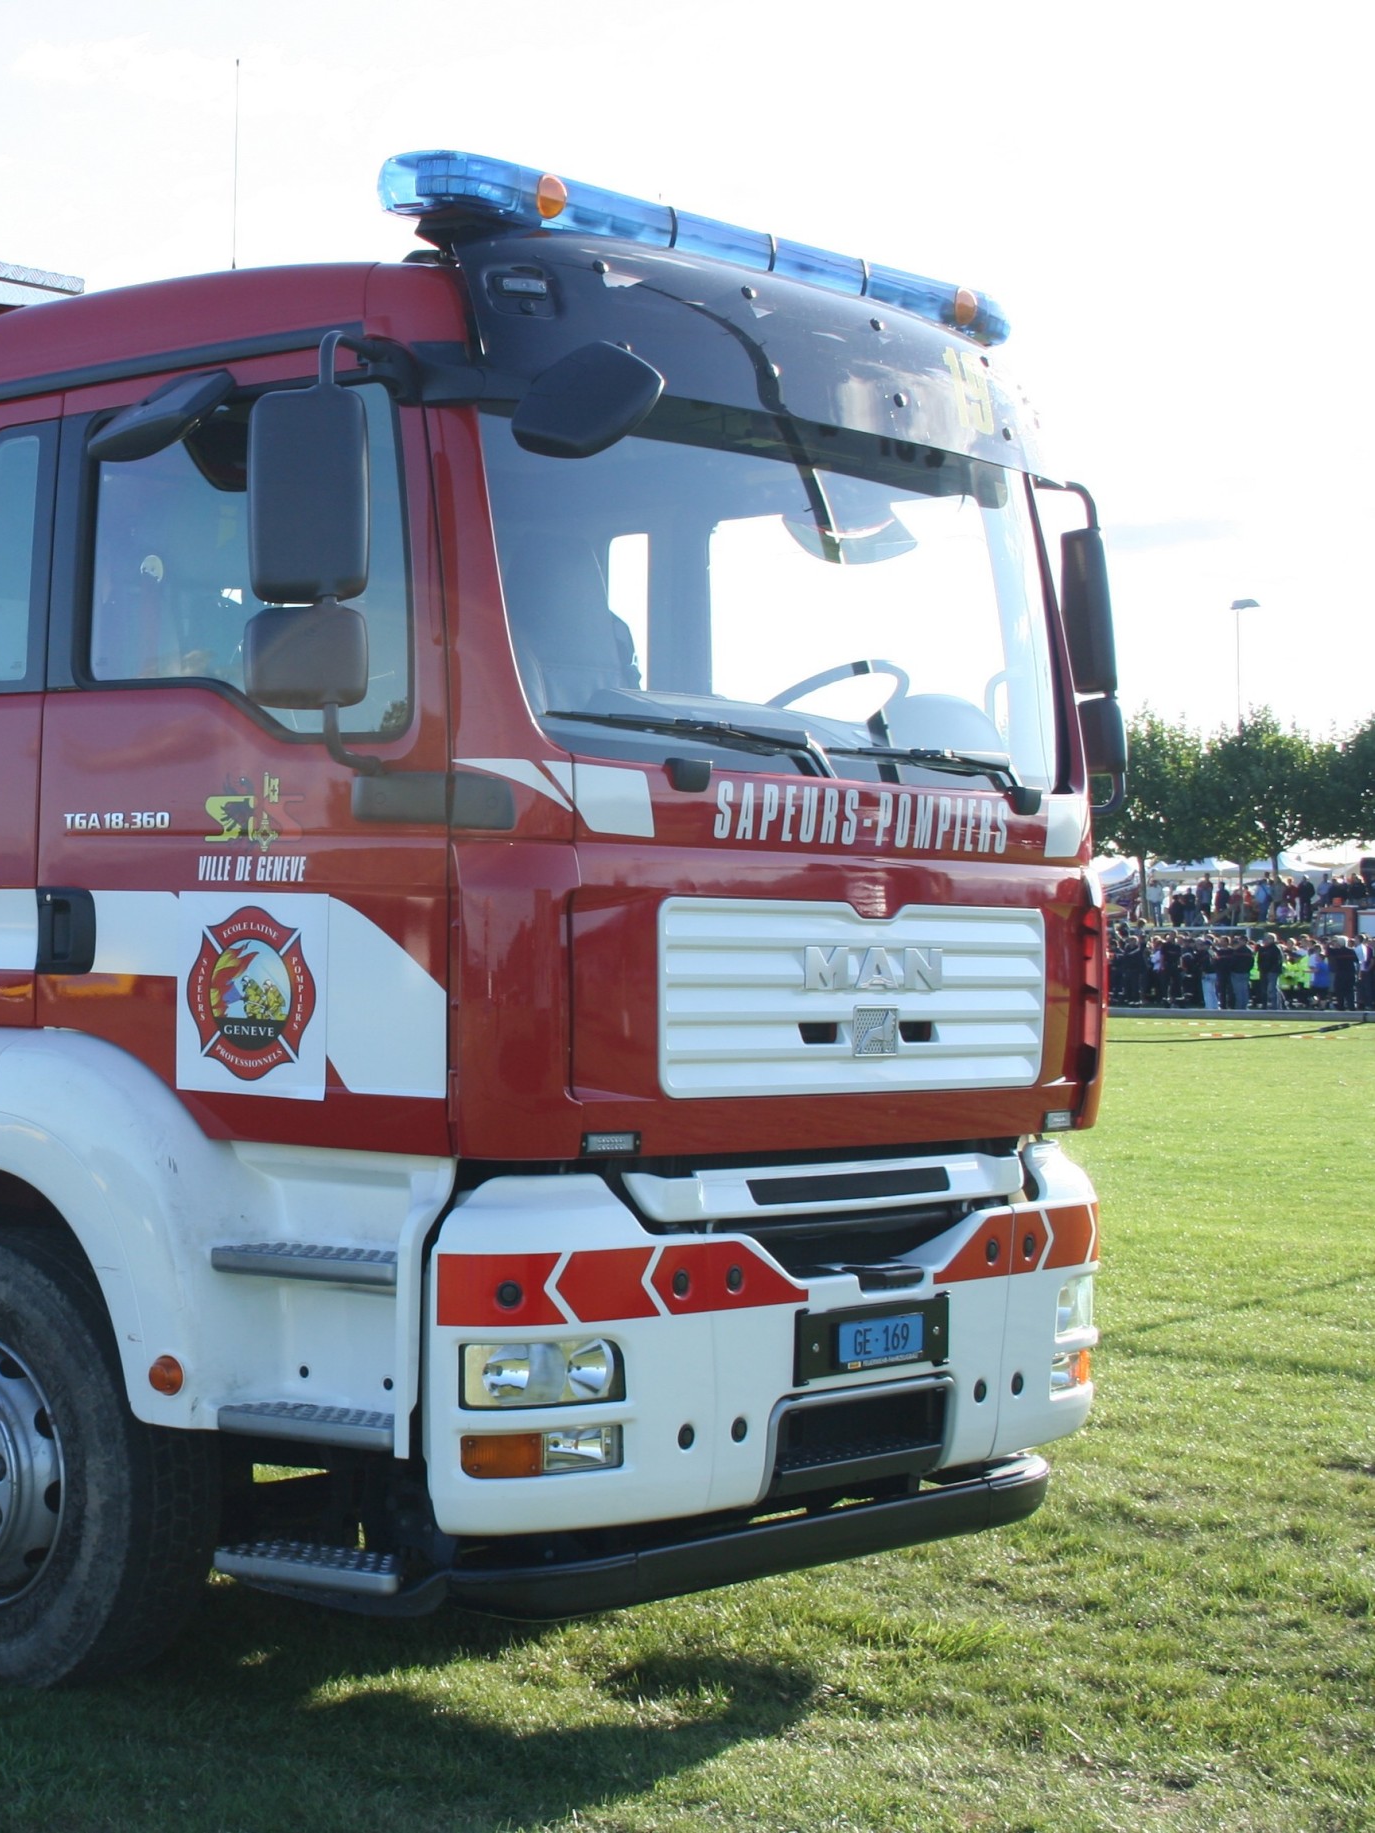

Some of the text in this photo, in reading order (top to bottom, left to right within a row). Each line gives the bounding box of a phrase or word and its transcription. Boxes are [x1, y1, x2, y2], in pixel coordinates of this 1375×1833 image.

[64, 812, 171, 830] TGA 18.360
[713, 780, 1008, 854] SAPEURS-POMPIERS
[198, 855, 307, 882] VILLE DE GENEVE
[223, 922, 279, 940] ECOLE LATINE
[803, 945, 943, 991] MAN
[197, 957, 208, 1021] SAPEURS
[292, 956, 305, 1031] POMPIERS
[223, 1024, 275, 1037] GENEVE
[215, 1044, 284, 1068] PROFESSIONNELS
